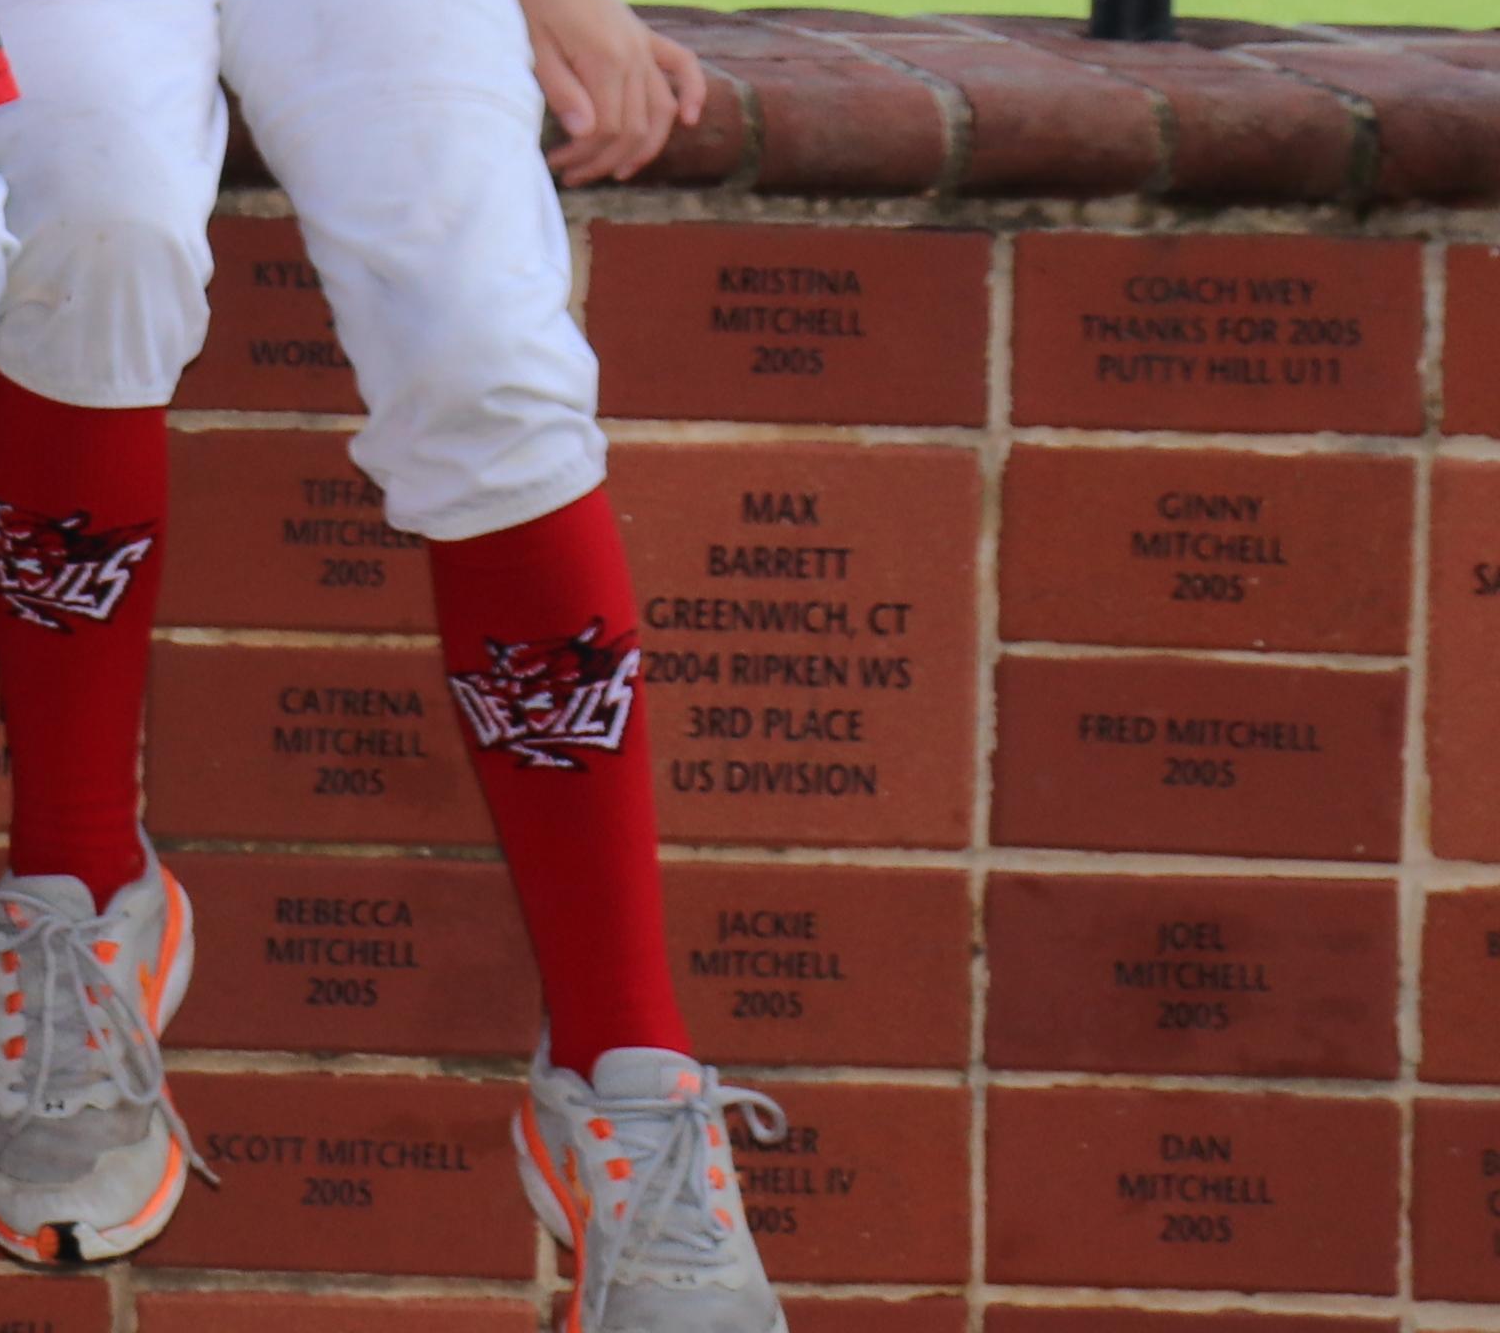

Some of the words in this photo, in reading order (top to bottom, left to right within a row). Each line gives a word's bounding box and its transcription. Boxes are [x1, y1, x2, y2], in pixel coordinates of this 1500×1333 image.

[253, 261, 320, 289] KYL
[718, 266, 862, 296] KRISTINA
[1125, 276, 1238, 305] COACH
[1247, 278, 1314, 306] WEY
[711, 306, 862, 337] MITCHELL
[1082, 314, 1206, 343] THANKS
[1217, 317, 1278, 346] FOR
[1290, 318, 1362, 346] 2005
[751, 345, 824, 375] 2005
[1098, 352, 1192, 383] PUTTY
[1206, 357, 1271, 385] HILL
[743, 493, 818, 525] MAX
[1157, 493, 1261, 523] GINNY
[708, 545, 850, 580] BARRETT
[1132, 531, 1287, 566] MITCHELL
[320, 559, 384, 587] 2005
[1172, 572, 1245, 603] 2005
[645, 597, 855, 637] GREENWICH,
[867, 603, 911, 637] CT
[645, 653, 721, 684] 2004
[731, 654, 848, 688] RIPKEN
[859, 657, 911, 690] WS
[280, 688, 423, 717] CATRENA
[690, 707, 750, 739] 3RD
[763, 707, 861, 743] PLACE
[1079, 714, 1156, 744] FRED
[1166, 718, 1320, 752] MITCHELL
[273, 727, 427, 758] MITCHELL
[314, 767, 385, 795] 2005
[671, 761, 715, 793] US
[726, 761, 876, 796] DIVISION
[1162, 757, 1236, 789] 2005
[275, 897, 412, 928] REBECCA
[719, 911, 815, 941] JACKIE
[1158, 922, 1226, 952] JOEL
[266, 937, 418, 969] MITCHELL
[690, 949, 843, 981] MITCHELL
[1114, 960, 1267, 992] MITCHELL
[306, 977, 378, 1007] 2005
[732, 990, 803, 1019] 2005
[1157, 1000, 1229, 1030] 2005
[206, 1135, 304, 1163] SCOTT
[317, 1139, 469, 1171] MITCHELL
[1162, 1134, 1231, 1162] DAN
[302, 1178, 372, 1206] 2005
[1117, 1173, 1273, 1206] MITCHELL
[1161, 1215, 1233, 1243] 2005
